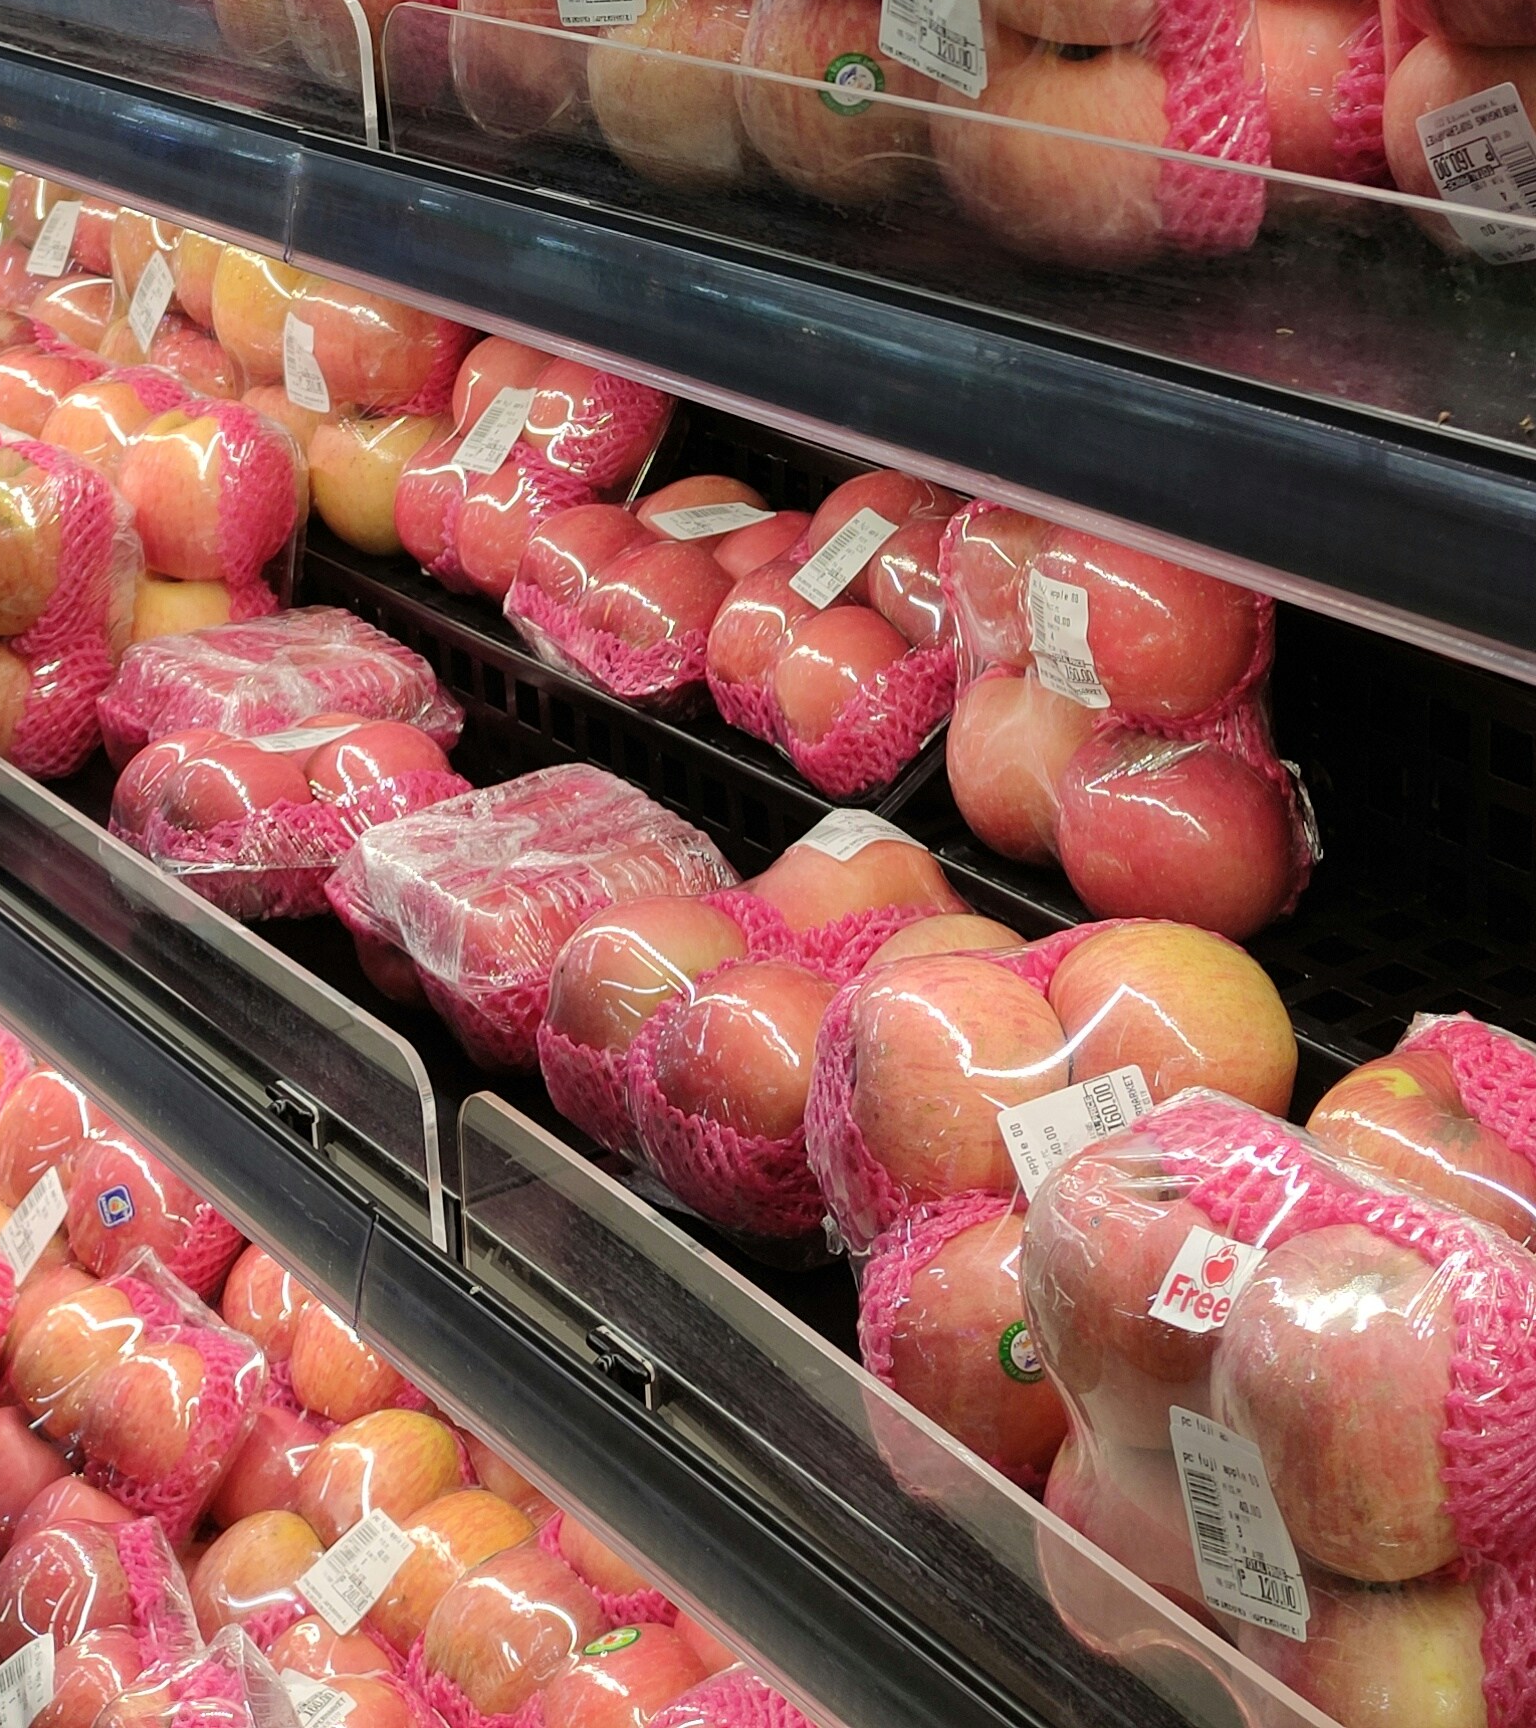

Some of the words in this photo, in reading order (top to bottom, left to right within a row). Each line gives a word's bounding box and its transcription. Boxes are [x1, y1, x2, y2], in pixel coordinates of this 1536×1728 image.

[1432, 147, 1475, 180] 160.00
[1092, 1082, 1126, 1132] 160.00
[1044, 1126, 1063, 1156] 40.00
[1020, 1142, 1039, 1176] apple
[1163, 1273, 1231, 1323] Free
[1258, 1574, 1296, 1609] 120.00
